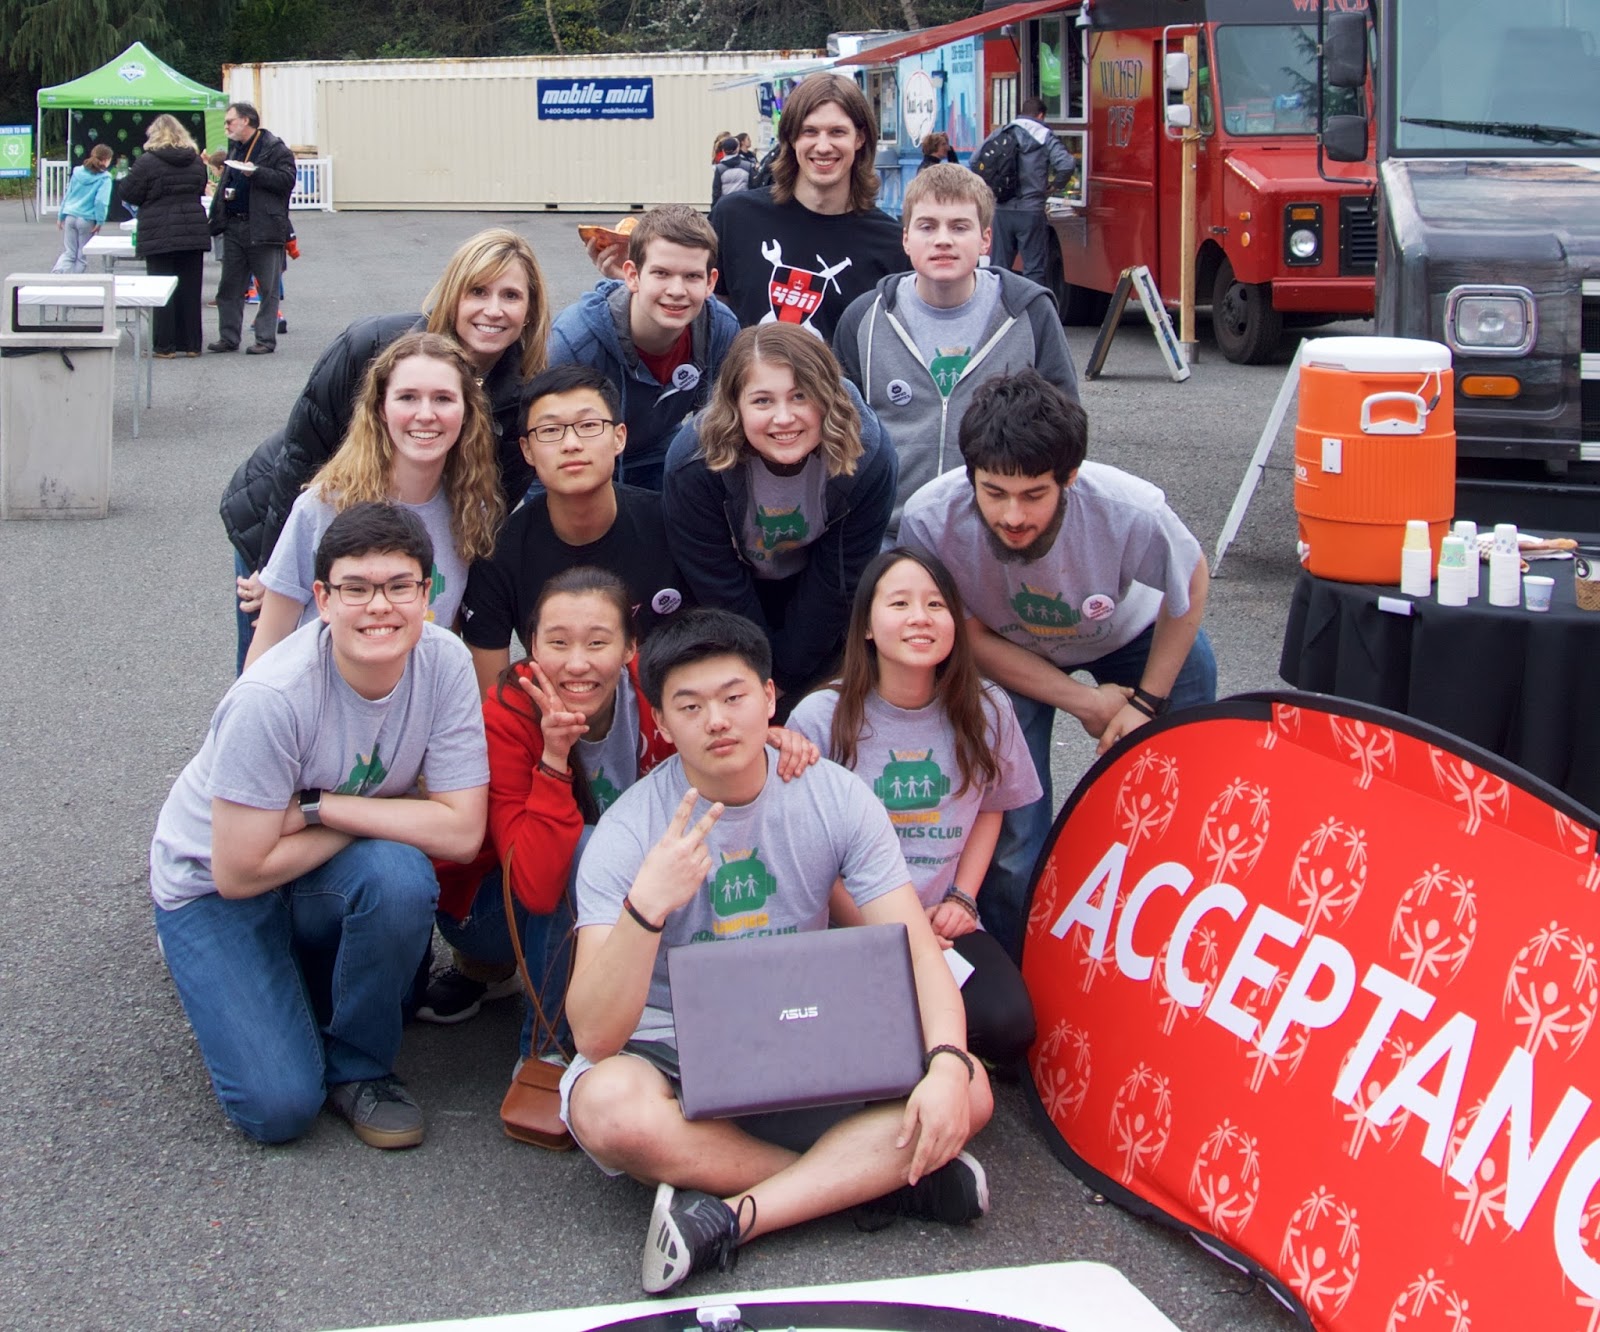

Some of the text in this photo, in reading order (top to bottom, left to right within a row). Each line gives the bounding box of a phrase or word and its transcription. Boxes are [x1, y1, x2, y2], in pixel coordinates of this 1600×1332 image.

[1100, 60, 1143, 99] WICKED
[93, 98, 154, 106] SOUNDERS FC
[541, 82, 648, 105] mobile mini
[1107, 105, 1135, 147] PIES
[895, 826, 963, 840] TICS CLUB
[779, 1006, 819, 1021] ASUS
